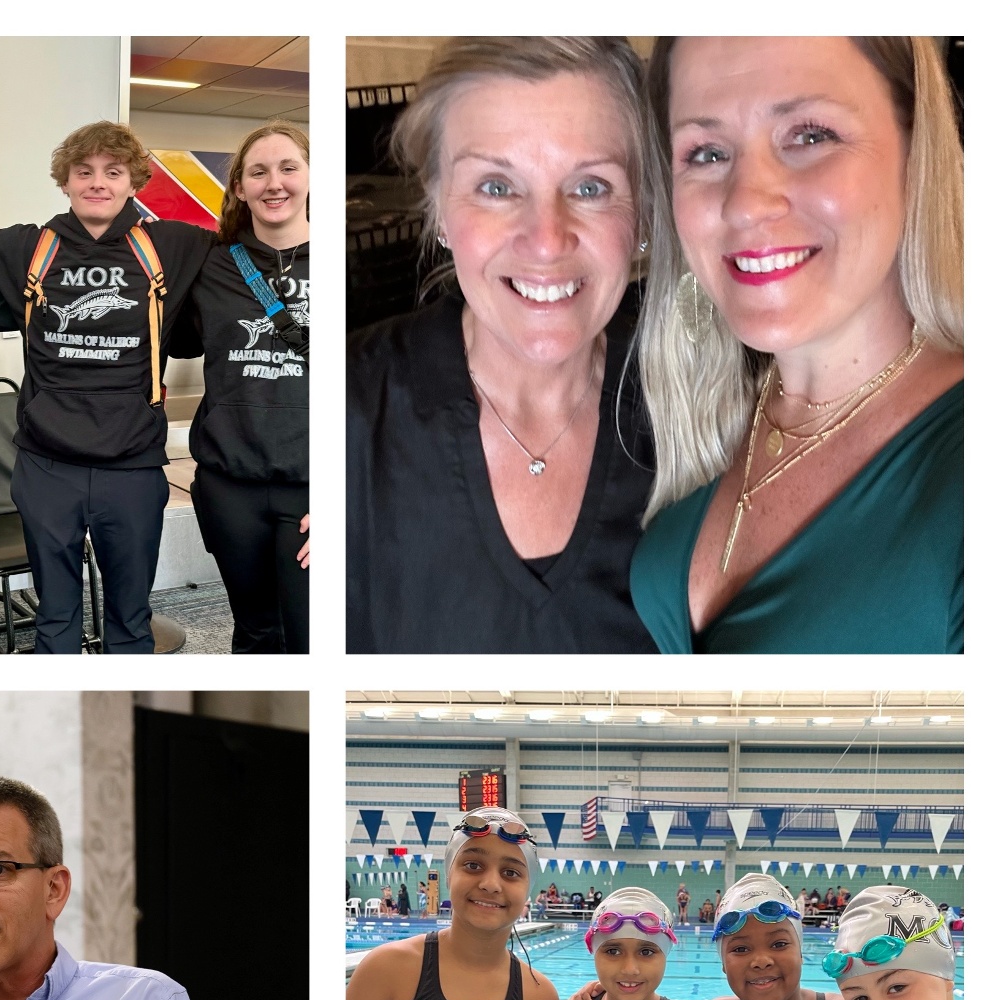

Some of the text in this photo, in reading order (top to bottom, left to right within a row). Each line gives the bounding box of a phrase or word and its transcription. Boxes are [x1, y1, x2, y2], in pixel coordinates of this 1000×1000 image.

[60, 267, 128, 287] MOR
[44, 331, 140, 348] MARLINS OF RALEIGH
[58, 347, 120, 360] SWIMMING
[228, 350, 272, 362] MARLINS
